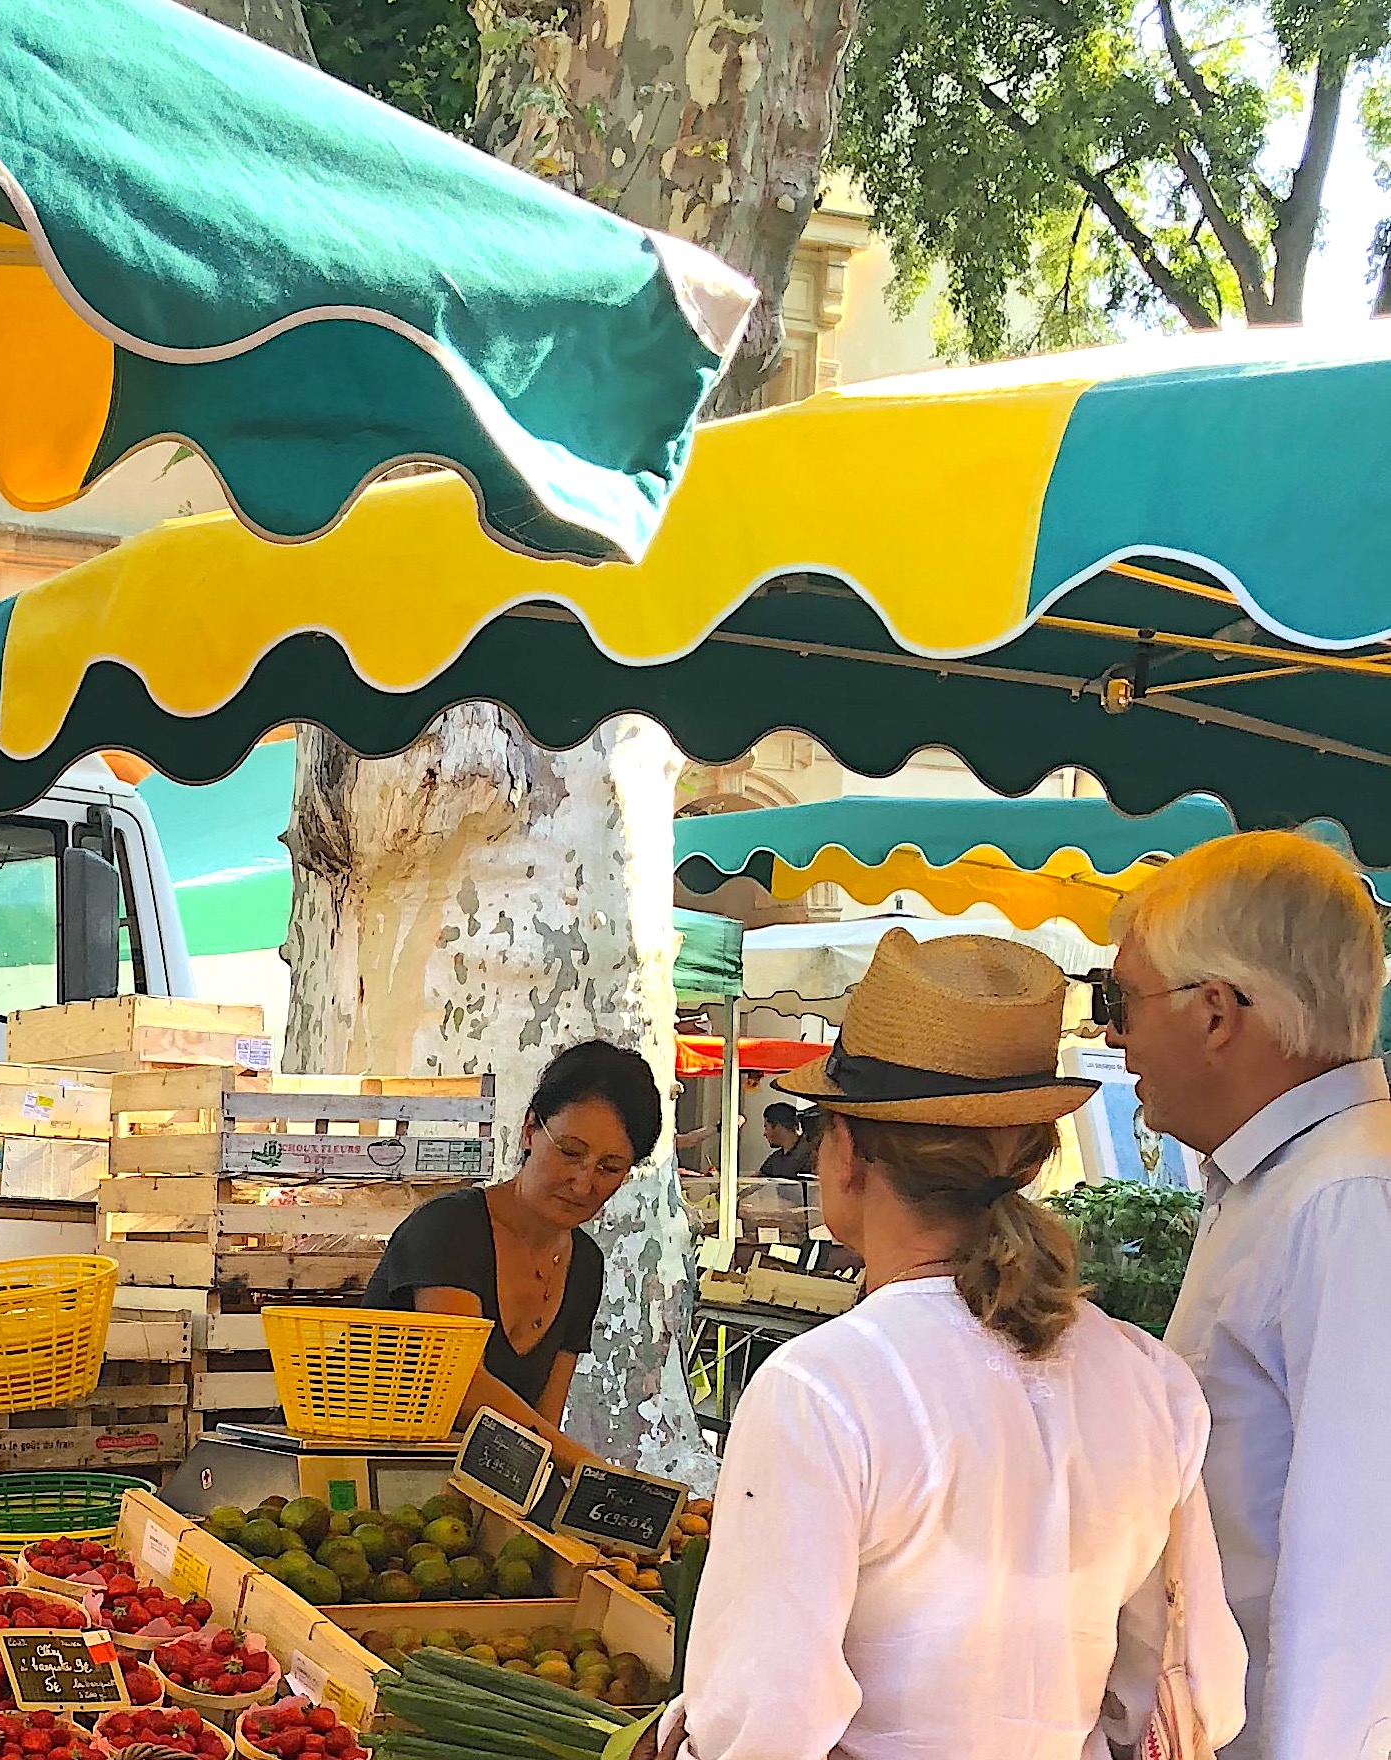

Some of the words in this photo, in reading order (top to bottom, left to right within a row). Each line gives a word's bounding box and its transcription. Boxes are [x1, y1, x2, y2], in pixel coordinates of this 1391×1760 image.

[281, 1143, 319, 1154] CHOUX
[320, 1144, 361, 1154] FLEURS
[9, 1440, 18, 1451] le
